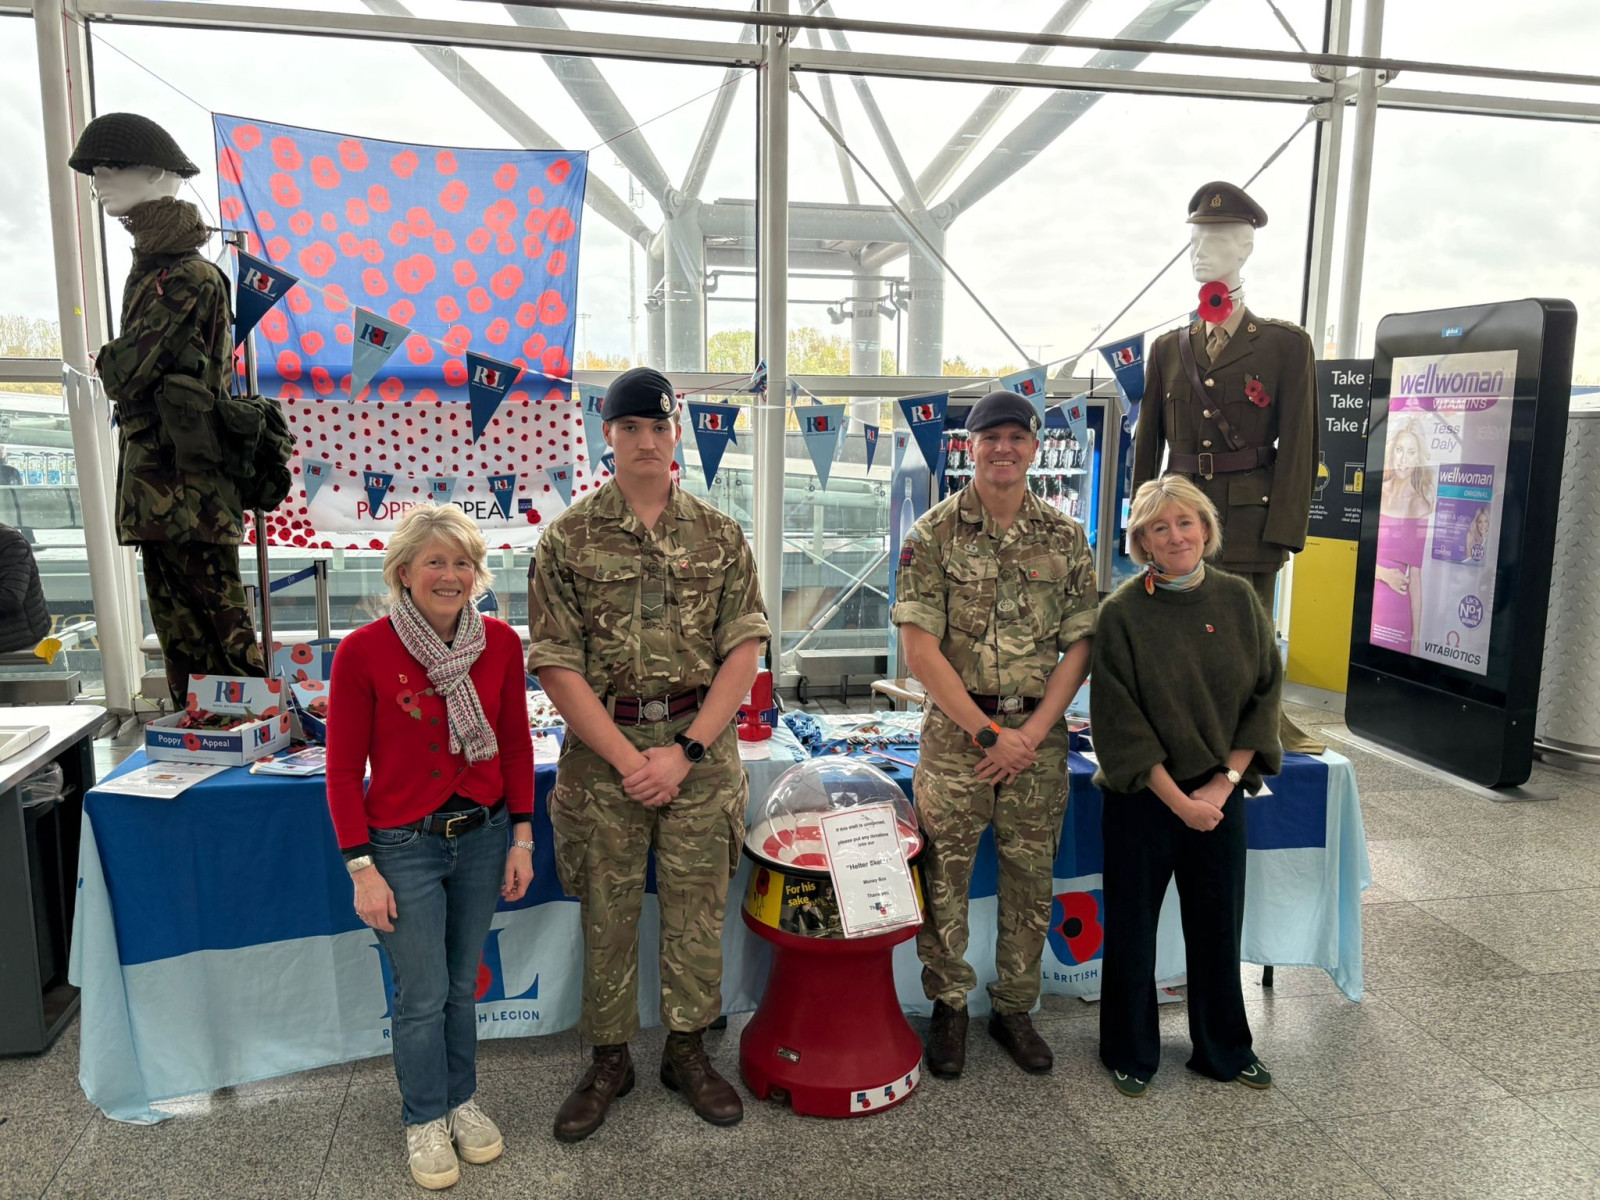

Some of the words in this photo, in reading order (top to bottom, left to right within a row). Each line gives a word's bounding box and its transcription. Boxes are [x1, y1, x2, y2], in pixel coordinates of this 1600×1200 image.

[1331, 370, 1365, 385] Take
[1400, 363, 1504, 395] wellwoman
[1329, 394, 1364, 409] Take
[1432, 398, 1488, 409] VITAMINS
[1325, 417, 1359, 432] Take
[1433, 421, 1460, 436] Tess
[1430, 437, 1458, 453] Daly
[1440, 467, 1493, 485] wellwoman
[1424, 642, 1482, 666] VITABIOTICS
[158, 734, 182, 746] Poppy
[202, 738, 230, 748] Appeal
[785, 885, 801, 895] For
[801, 881, 817, 893] his
[787, 895, 810, 907] sake
[1053, 968, 1098, 983] BRITISH
[492, 1010, 540, 1024] LEGION
